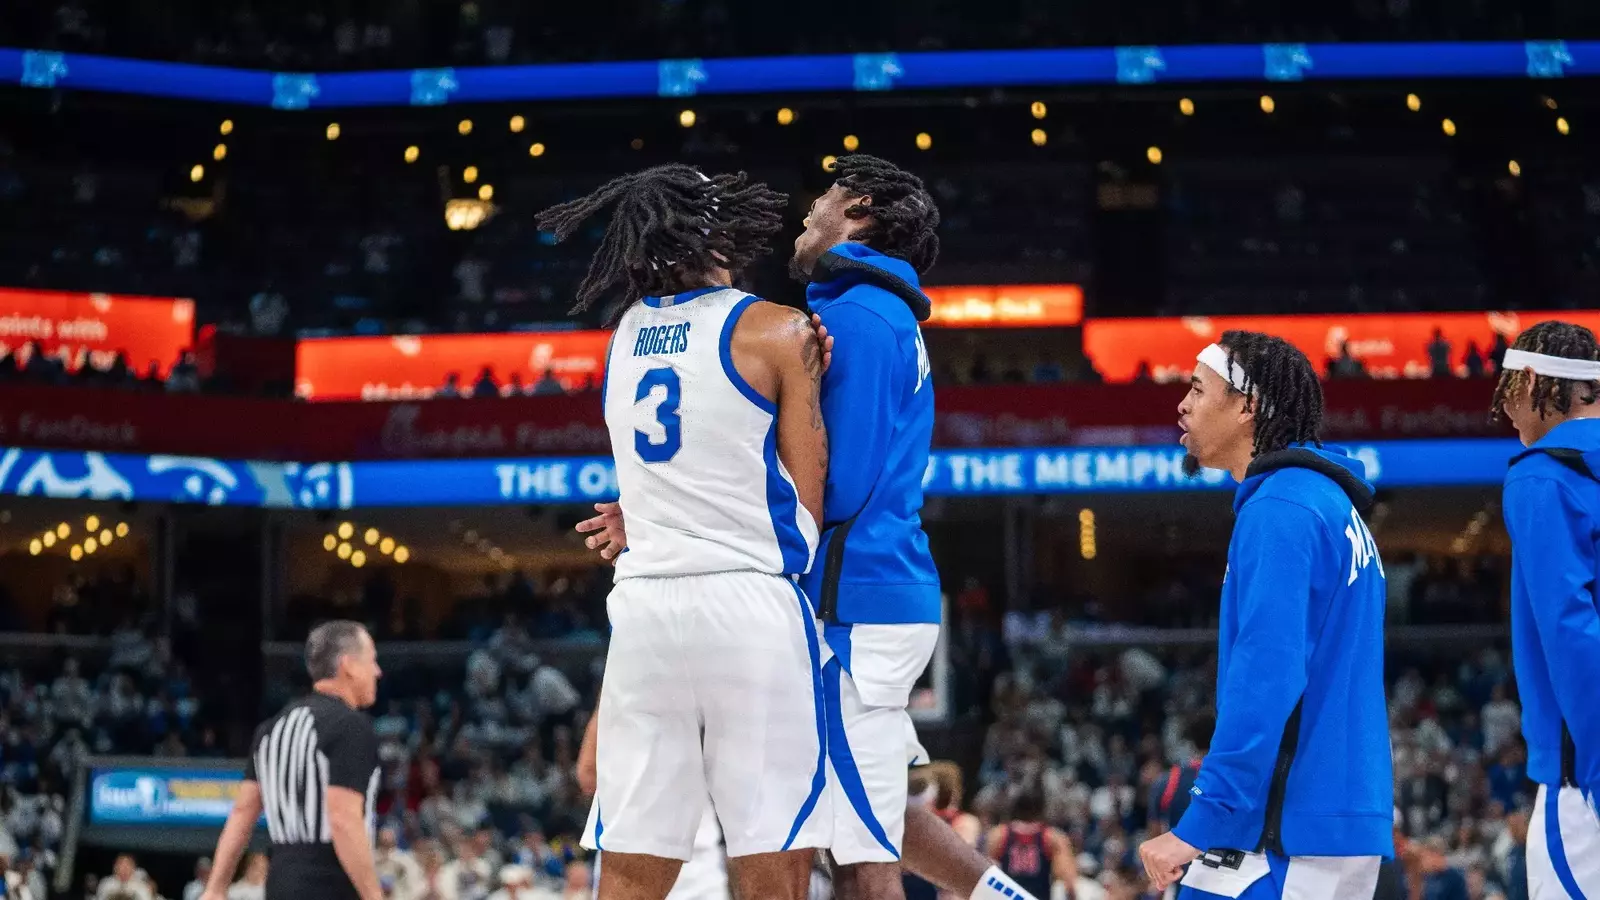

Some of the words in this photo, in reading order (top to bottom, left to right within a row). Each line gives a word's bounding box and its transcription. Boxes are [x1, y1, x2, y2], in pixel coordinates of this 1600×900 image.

[633, 321, 691, 357] ROGERS
[634, 366, 682, 464] 3
[496, 463, 570, 498] THE
[950, 453, 1022, 489] THE
[1034, 449, 1225, 488] MEMPH
